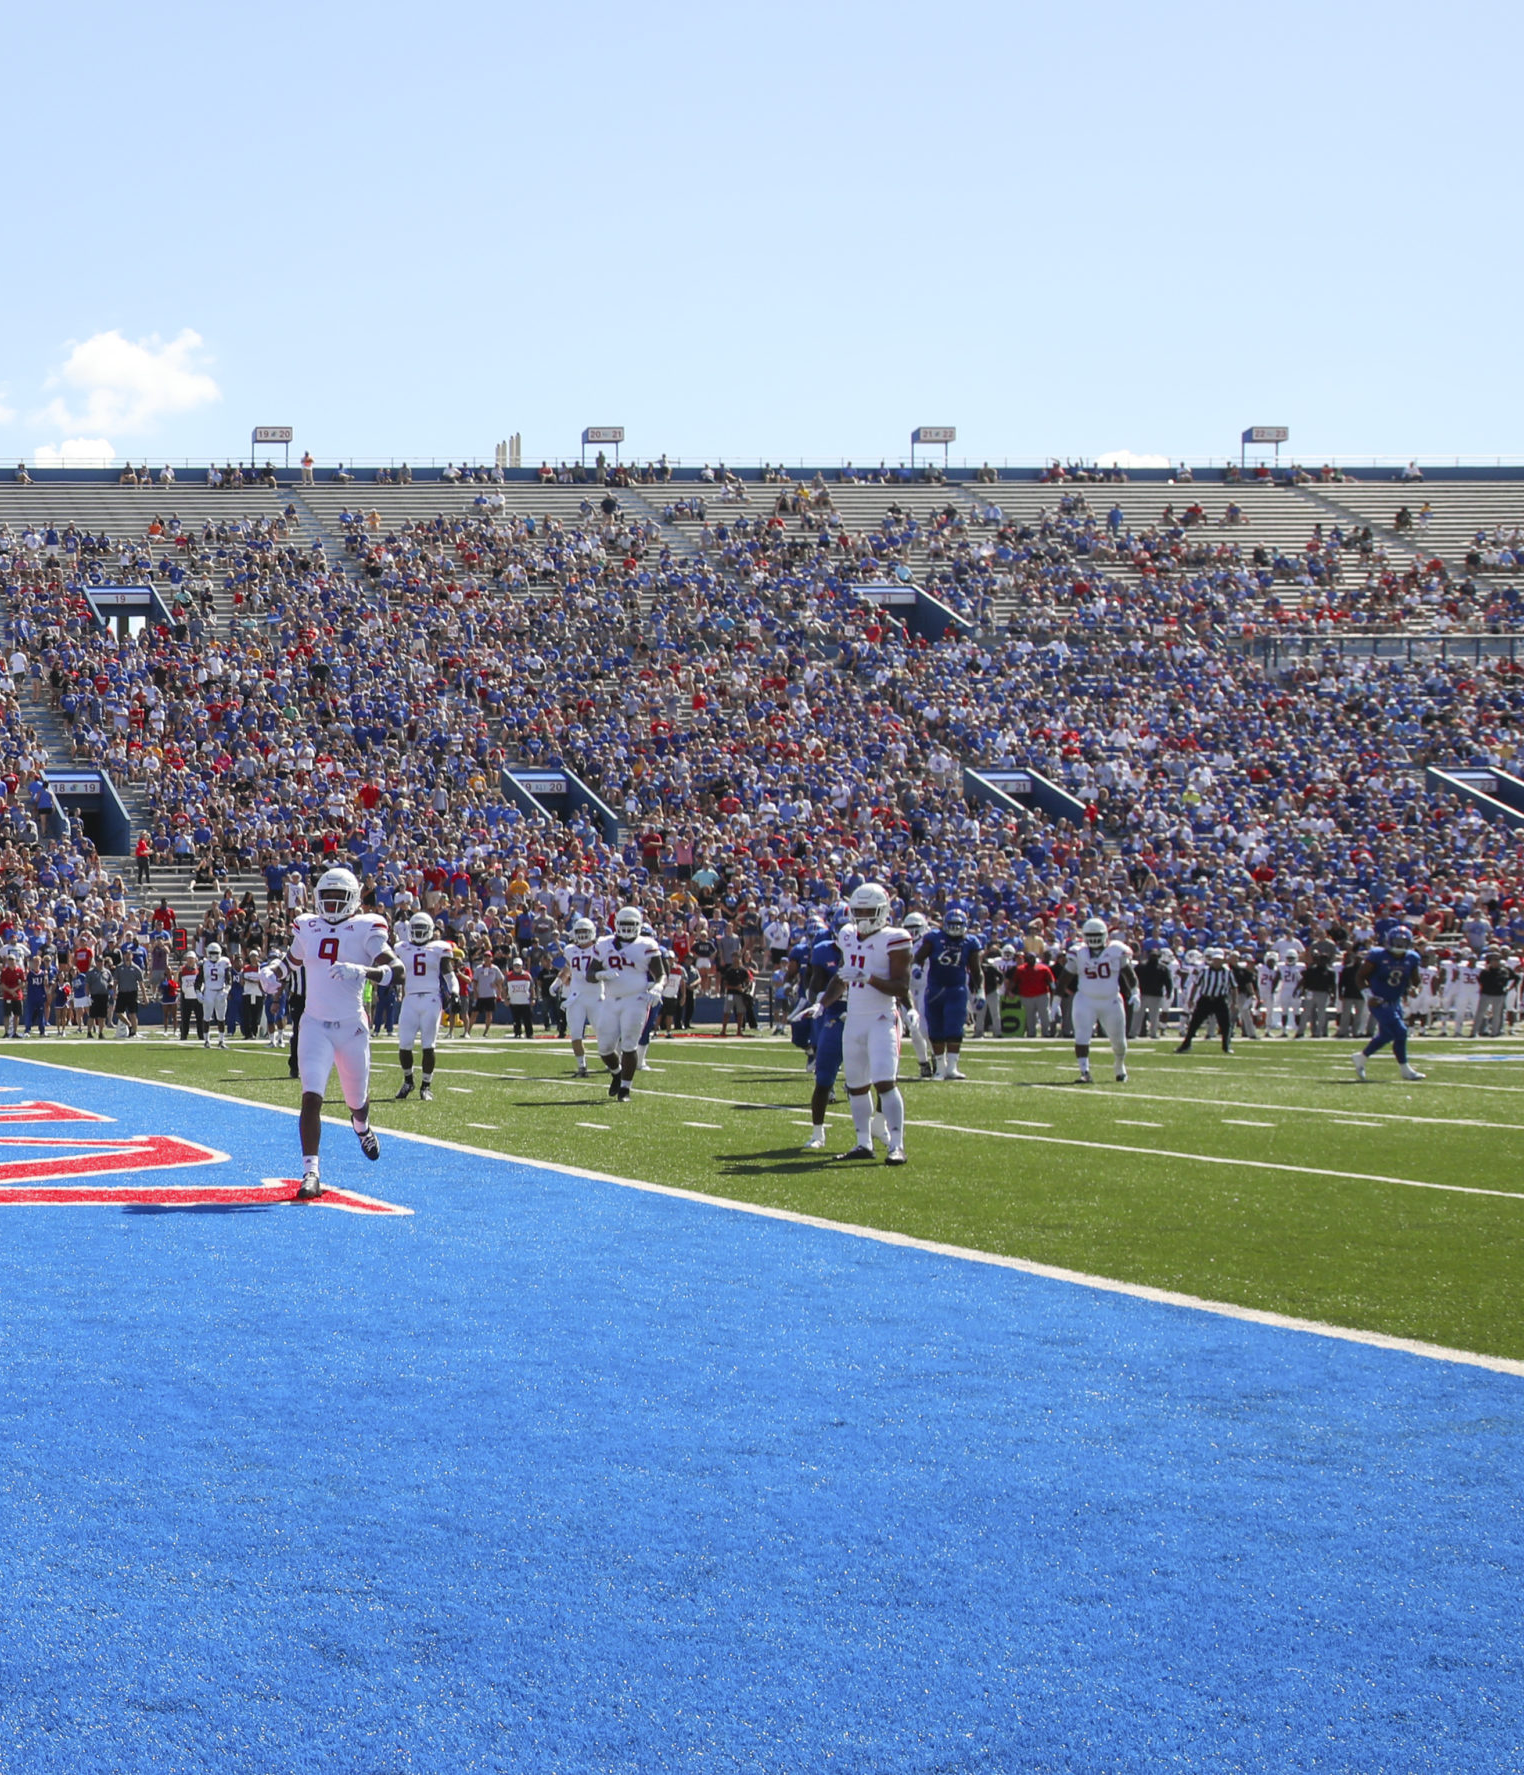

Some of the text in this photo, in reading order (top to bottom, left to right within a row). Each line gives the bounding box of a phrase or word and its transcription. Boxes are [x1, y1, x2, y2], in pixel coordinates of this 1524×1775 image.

[116, 595, 126, 603] 19
[54, 784, 95, 792] 18 19
[550, 783, 562, 791] 20
[1016, 783, 1026, 792] 21
[175, 929, 186, 950] 3
[318, 938, 340, 966] 9
[937, 951, 962, 967] 61
[413, 953, 426, 976] 6
[571, 955, 592, 971] 97
[210, 969, 219, 981] 5
[1387, 970, 1403, 987] 8
